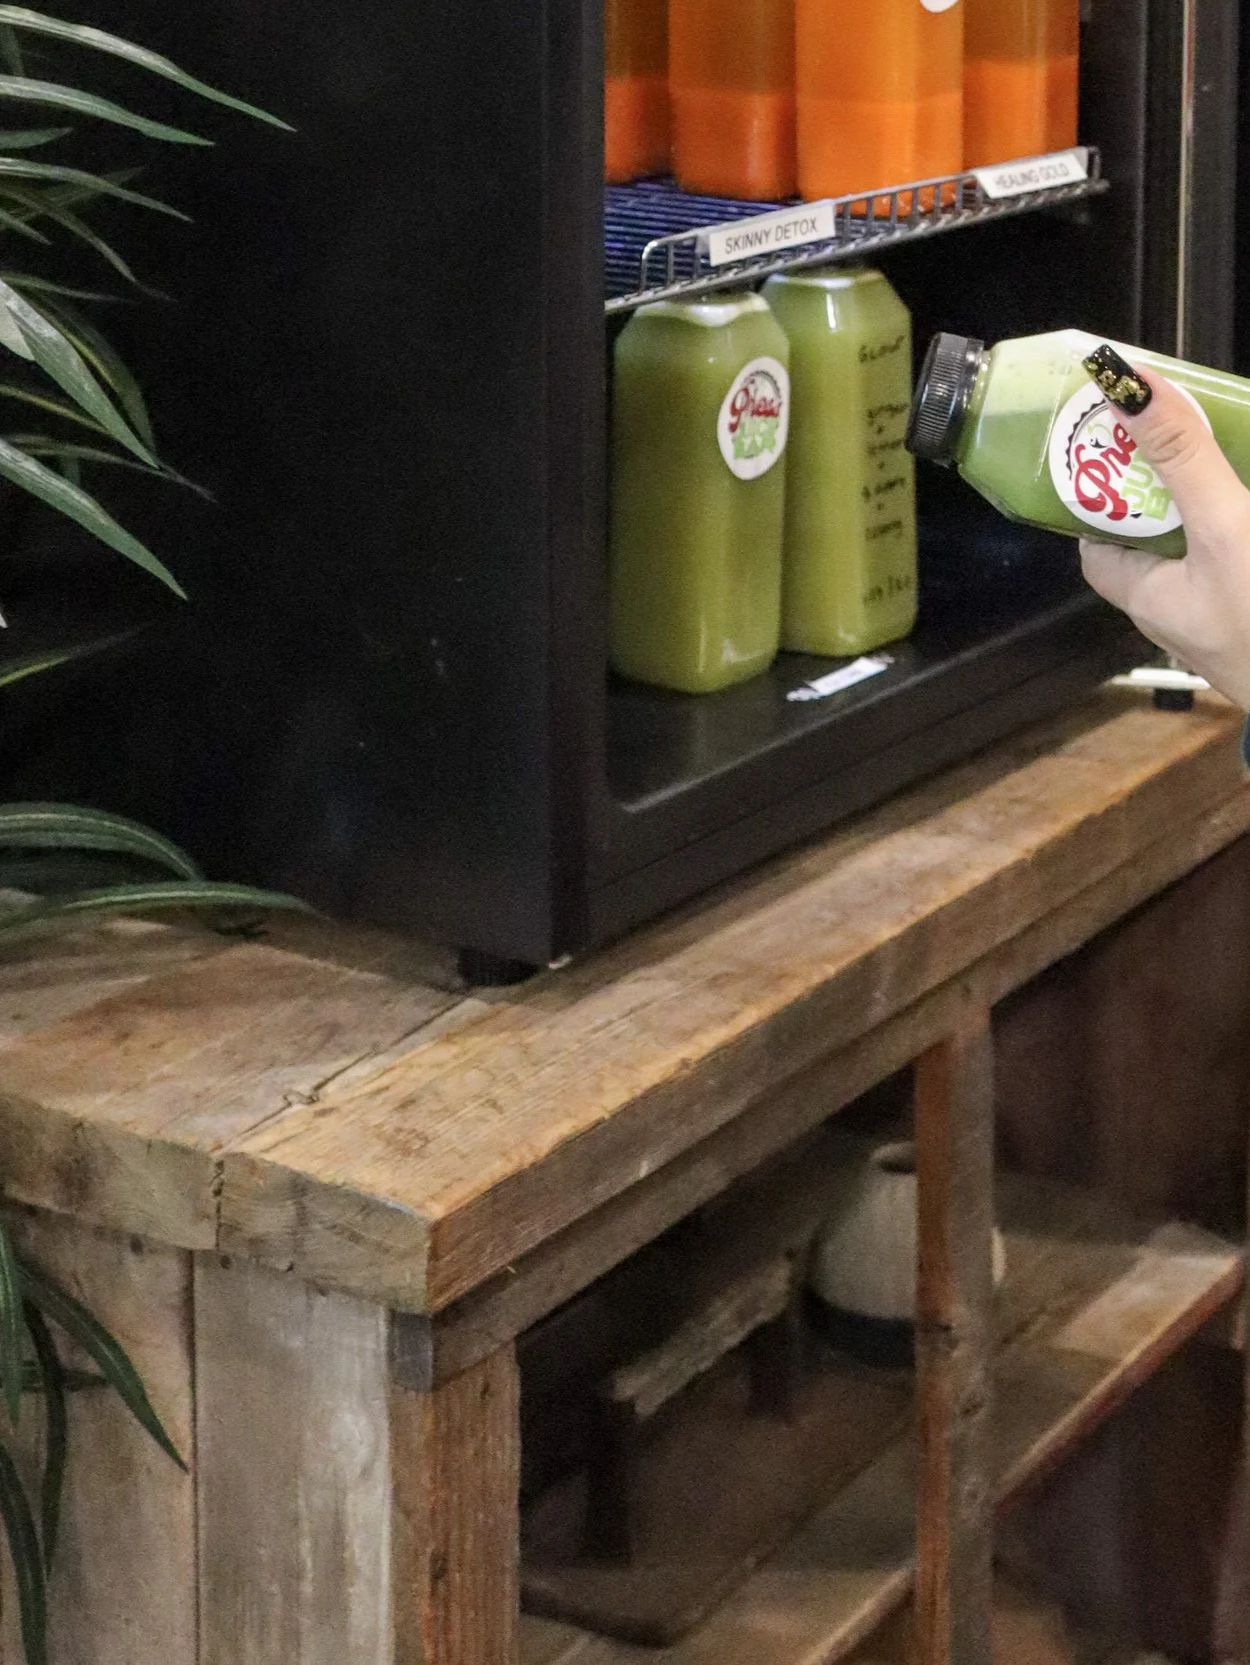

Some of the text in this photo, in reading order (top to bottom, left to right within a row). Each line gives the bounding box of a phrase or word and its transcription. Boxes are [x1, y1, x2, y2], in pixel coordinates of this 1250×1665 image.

[724, 217, 818, 254] SKINNY DETOX
[1074, 422, 1137, 521] Pre
